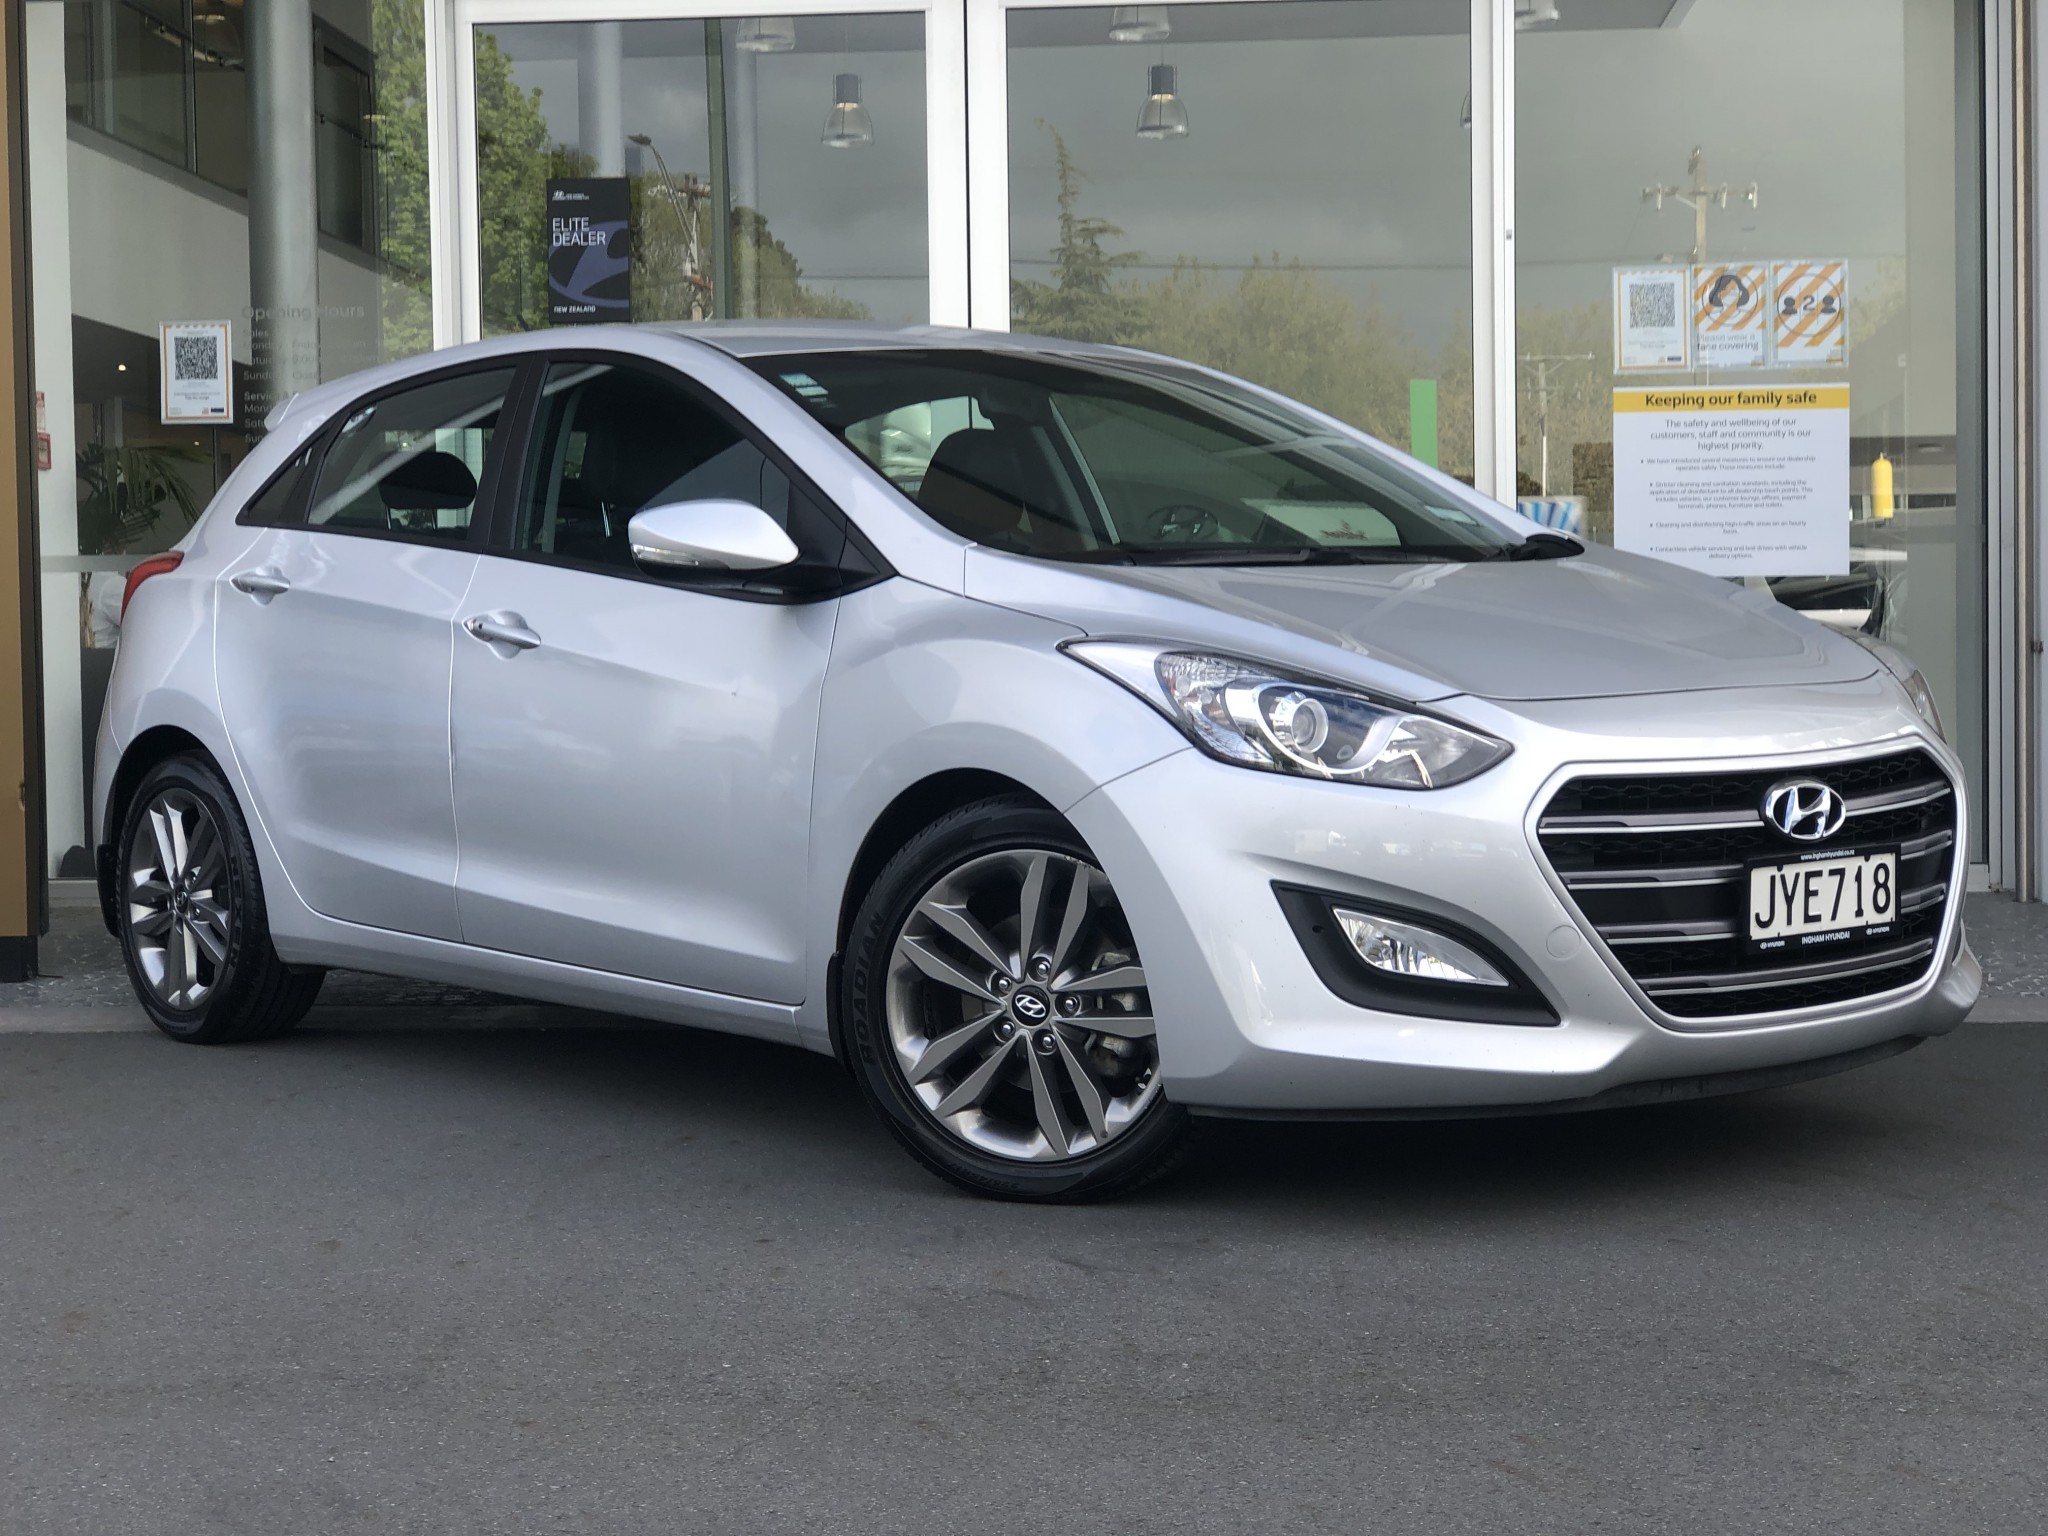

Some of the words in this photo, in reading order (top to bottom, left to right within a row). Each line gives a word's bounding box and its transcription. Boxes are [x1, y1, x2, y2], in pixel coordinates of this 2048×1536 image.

[552, 217, 590, 232] ELITE
[552, 231, 606, 247] DEALER
[242, 303, 313, 322] Opening
[1696, 342, 1717, 351] face
[1718, 341, 1760, 352] covering
[244, 391, 279, 401] Servic
[1645, 393, 1705, 409] Keeping
[1708, 394, 1733, 405] our
[1737, 391, 1782, 408] family
[1786, 390, 1817, 405] safe
[1665, 419, 1682, 428] The
[1683, 418, 1709, 430] safety
[1710, 419, 1727, 428] and
[1729, 418, 1770, 429] wellbeing
[1771, 417, 1781, 426] of
[1782, 418, 1797, 426] our
[1650, 431, 1697, 441] customers,
[1698, 430, 1718, 440] staff
[1720, 430, 1736, 439] and
[1738, 429, 1786, 440] community
[1788, 429, 1795, 437] is
[1796, 429, 1811, 437] our
[1697, 441, 1729, 452] highest
[1754, 862, 1891, 929] JYE718
[1872, 925, 1890, 934] HYUNDAI
[1767, 940, 1785, 949] HYUNDAI
[1801, 933, 1825, 945] INGHAM
[1825, 930, 1851, 942] HYUNDAI
[852, 911, 884, 1065] ROADIAN
